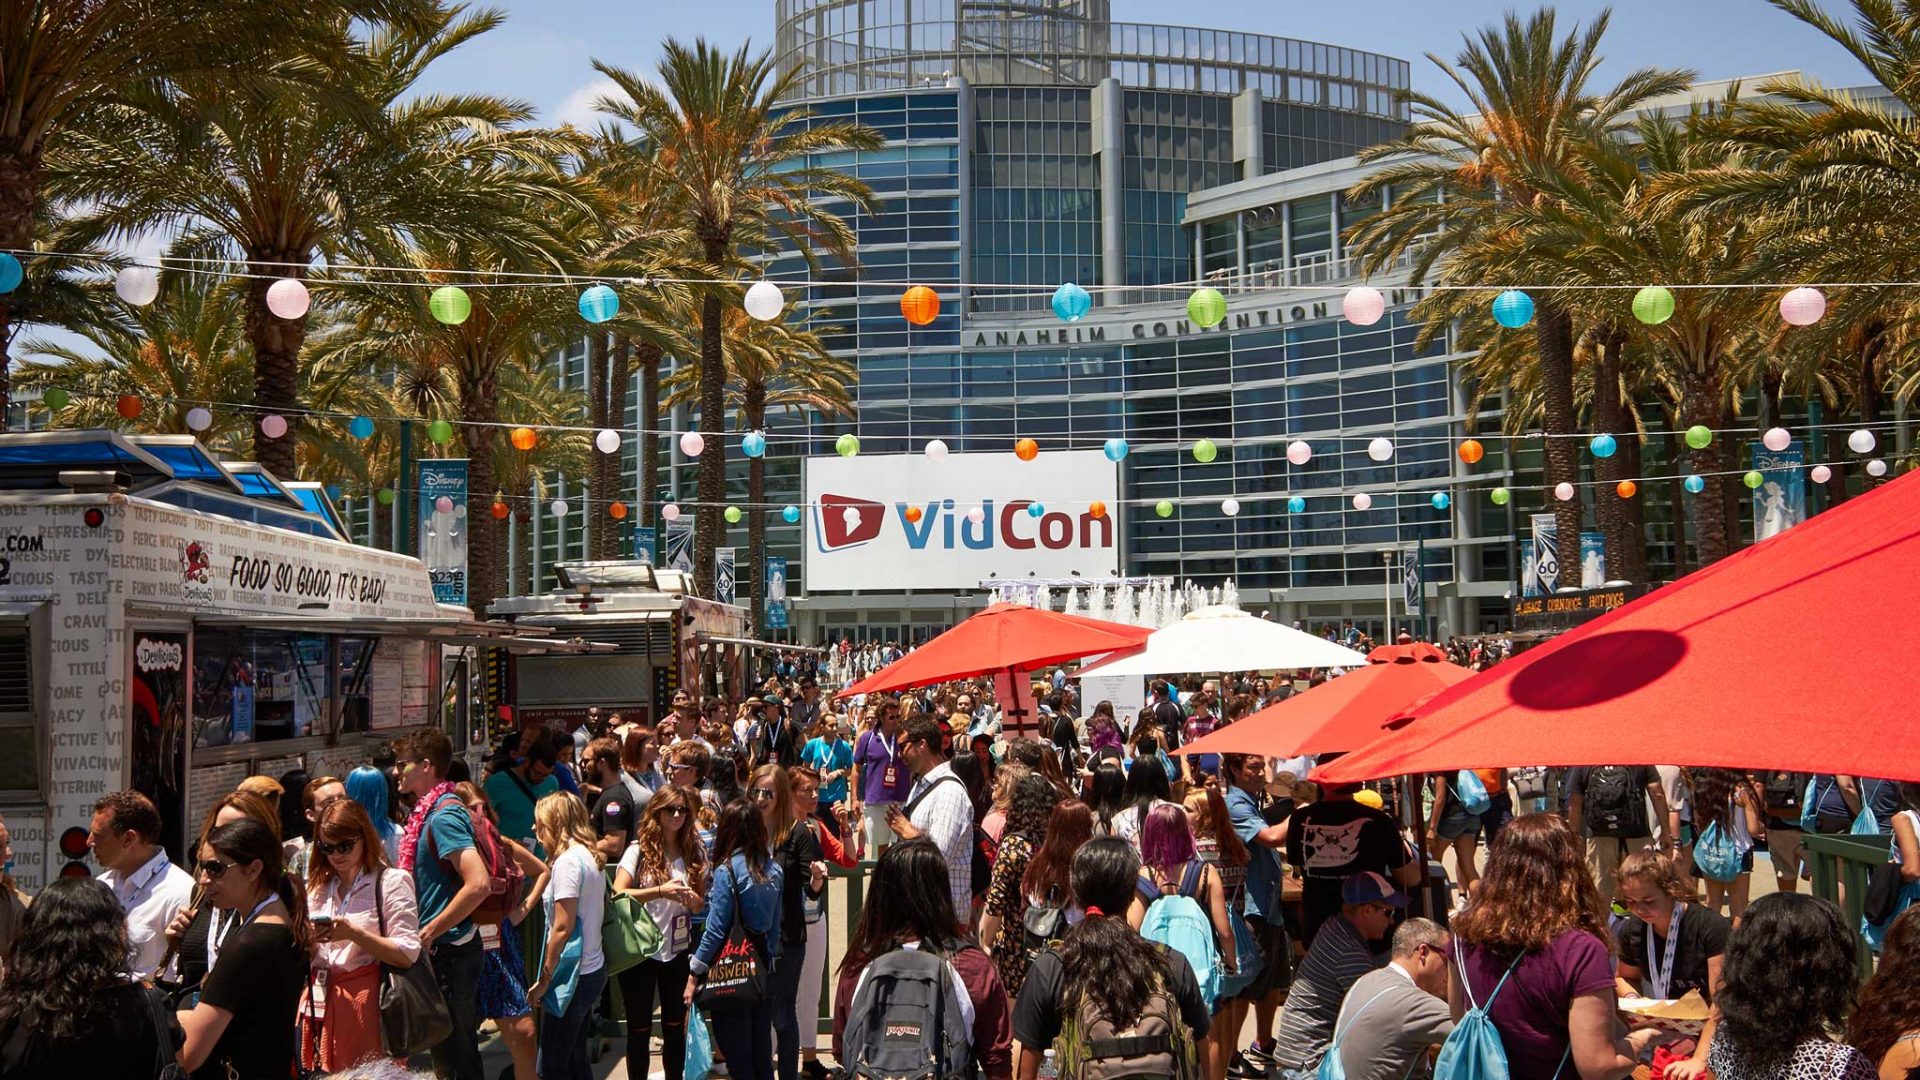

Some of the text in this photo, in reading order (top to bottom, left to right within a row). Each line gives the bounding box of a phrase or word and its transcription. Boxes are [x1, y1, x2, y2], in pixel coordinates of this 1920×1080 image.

[975, 302, 1327, 346] ANAHEIM CONENTION
[422, 472, 464, 489] Disney
[134, 507, 158, 522] TASTY
[896, 499, 1113, 549] VidCon
[1, 535, 44, 552] .COM
[1538, 561, 1557, 574] 60
[230, 555, 271, 590] FOOD
[274, 562, 293, 594] SO
[297, 566, 332, 601] GOOD,
[336, 572, 357, 601] IT'S
[359, 576, 386, 604] BAD!
[453, 571, 464, 595] 2015
[718, 579, 730, 588] 60
